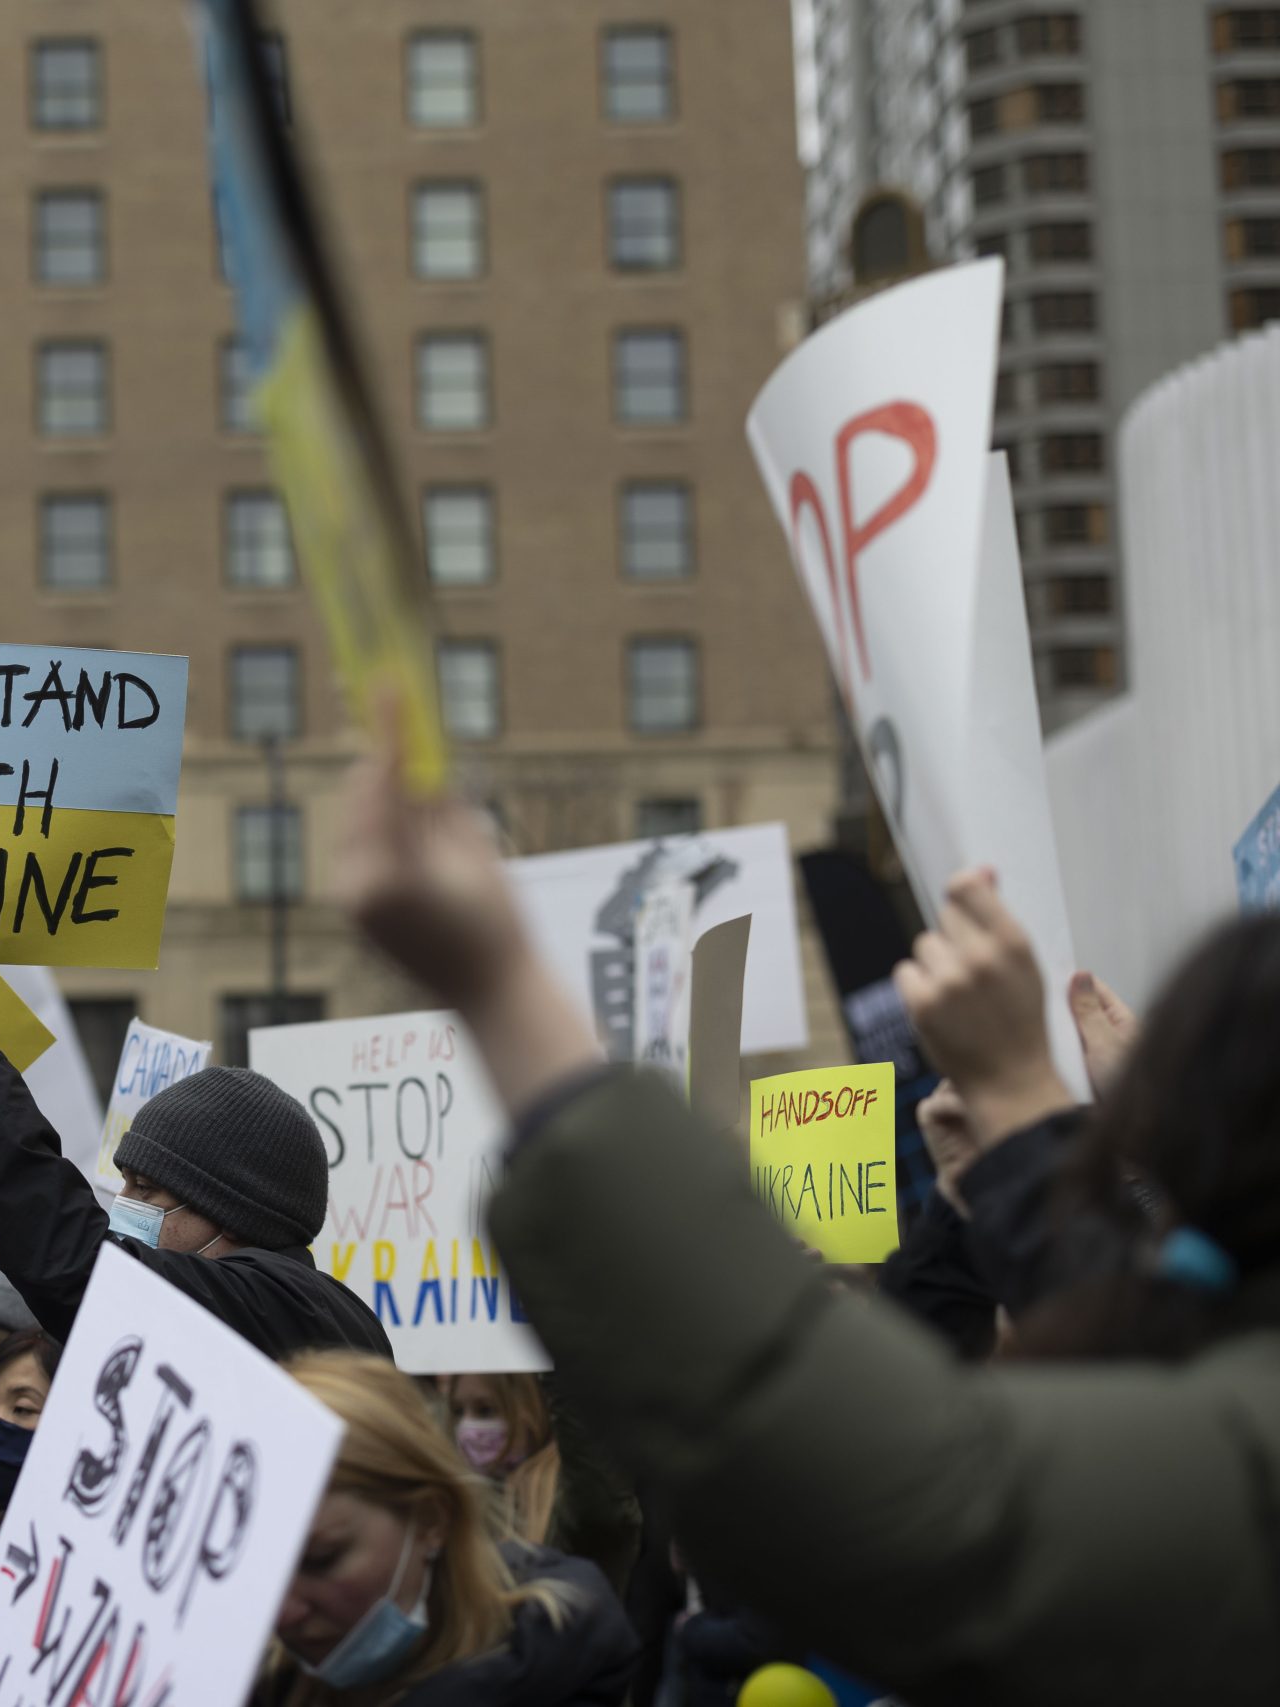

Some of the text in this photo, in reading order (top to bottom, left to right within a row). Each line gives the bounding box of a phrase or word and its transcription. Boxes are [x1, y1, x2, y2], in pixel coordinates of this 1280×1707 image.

[352, 1025, 457, 1072] HELP US
[309, 1073, 454, 1169] STOP
[328, 1160, 438, 1240] WAR
[308, 1235, 529, 1328] KRAIN
[63, 1334, 258, 1634] STOP
